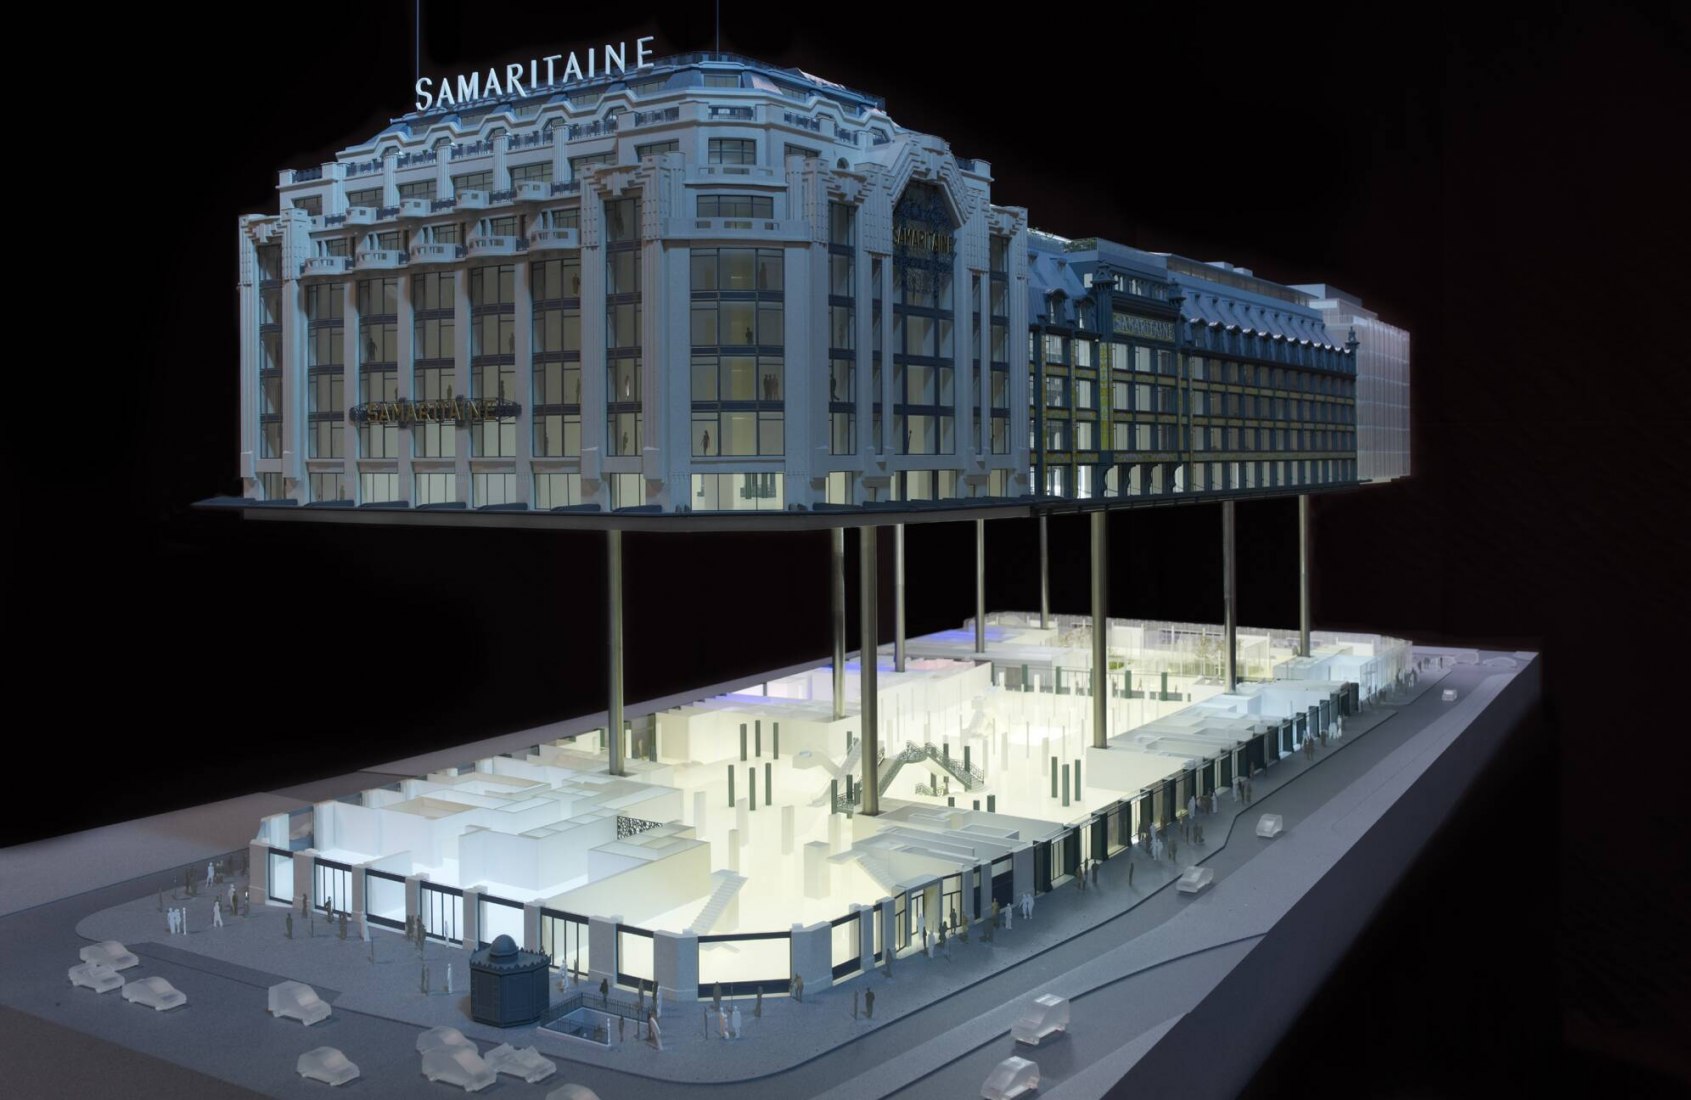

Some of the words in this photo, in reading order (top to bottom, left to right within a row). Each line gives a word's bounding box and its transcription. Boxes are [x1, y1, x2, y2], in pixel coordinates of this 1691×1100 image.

[415, 36, 655, 112] SAMARITAINE
[893, 225, 955, 254] SAMARITAINE
[366, 399, 498, 422] SAMARITAINE
